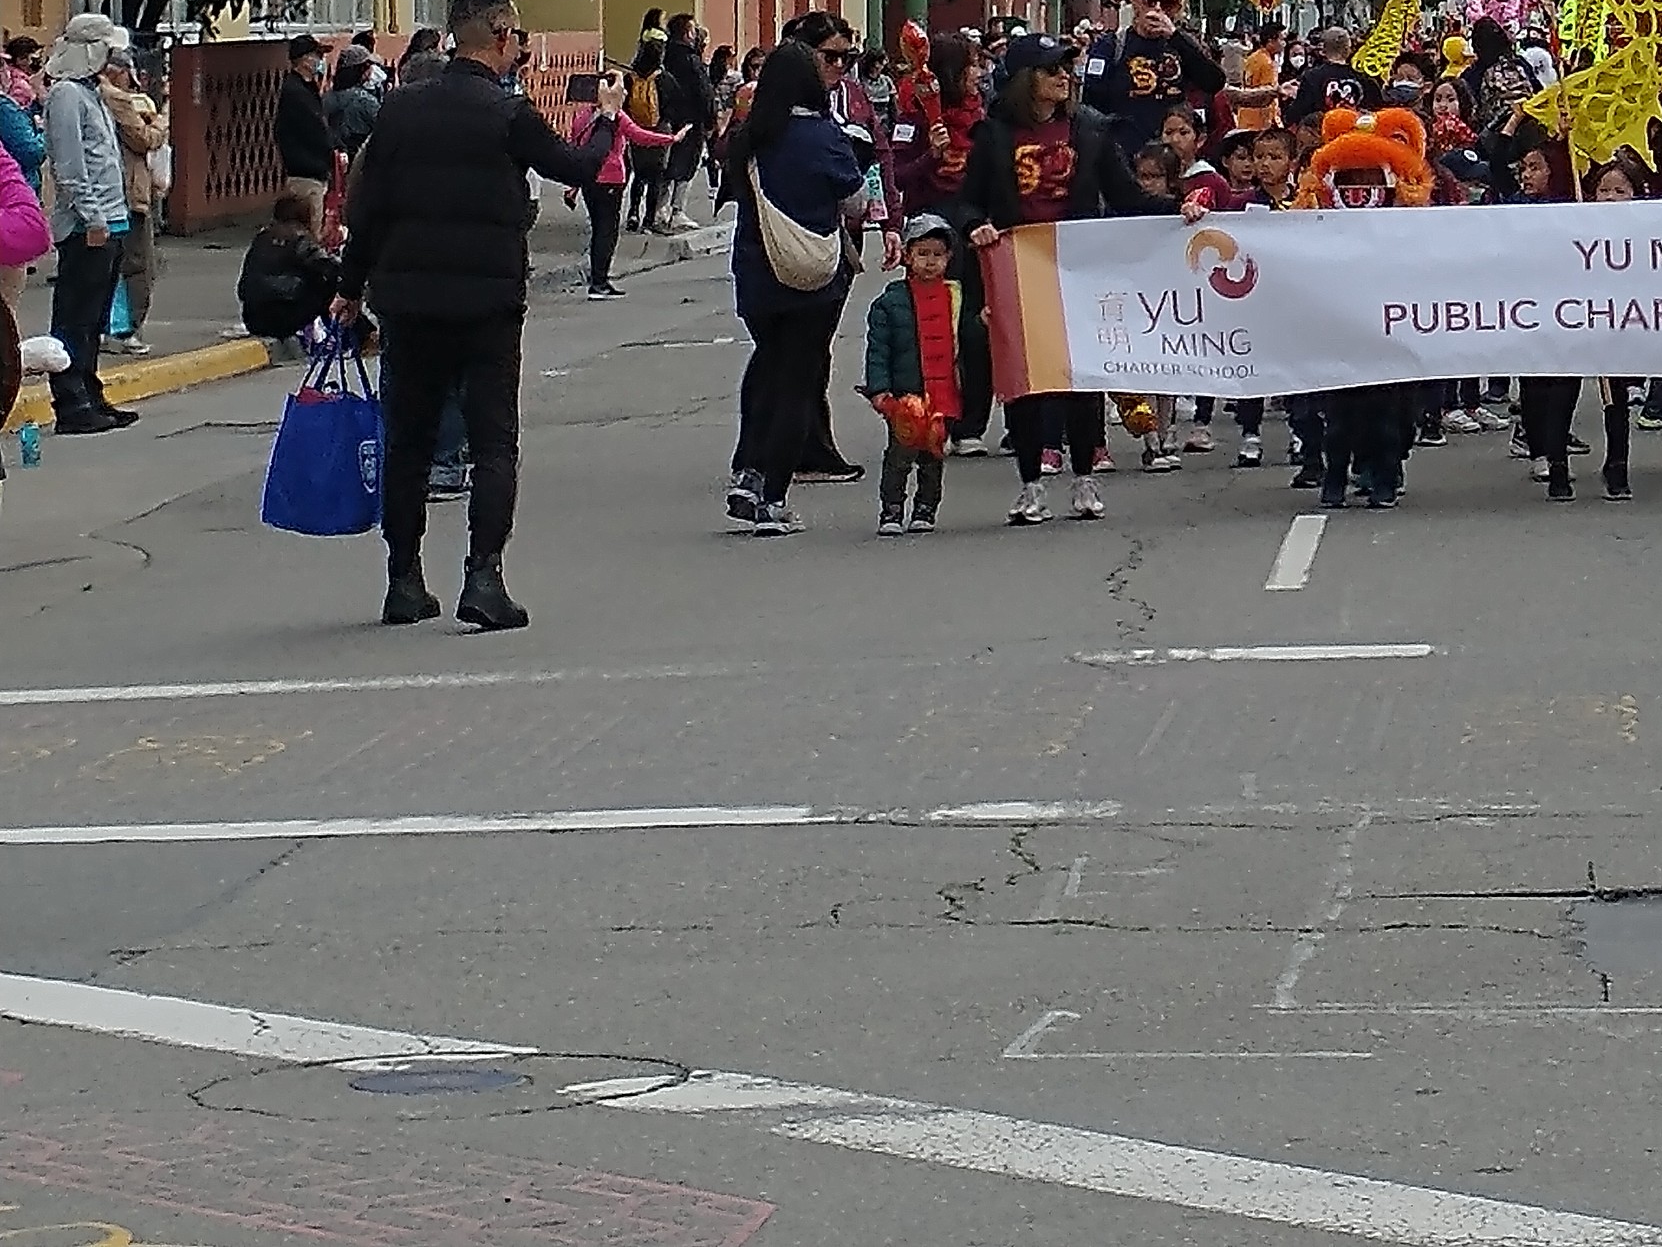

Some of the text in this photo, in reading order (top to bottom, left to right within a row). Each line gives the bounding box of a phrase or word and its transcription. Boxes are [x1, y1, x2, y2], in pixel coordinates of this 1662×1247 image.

[1573, 238, 1632, 271] YU
[1382, 300, 1540, 336] PUBLIC
[1161, 328, 1251, 357] MING
[1103, 361, 1259, 379] CHARTER SCHOOL
